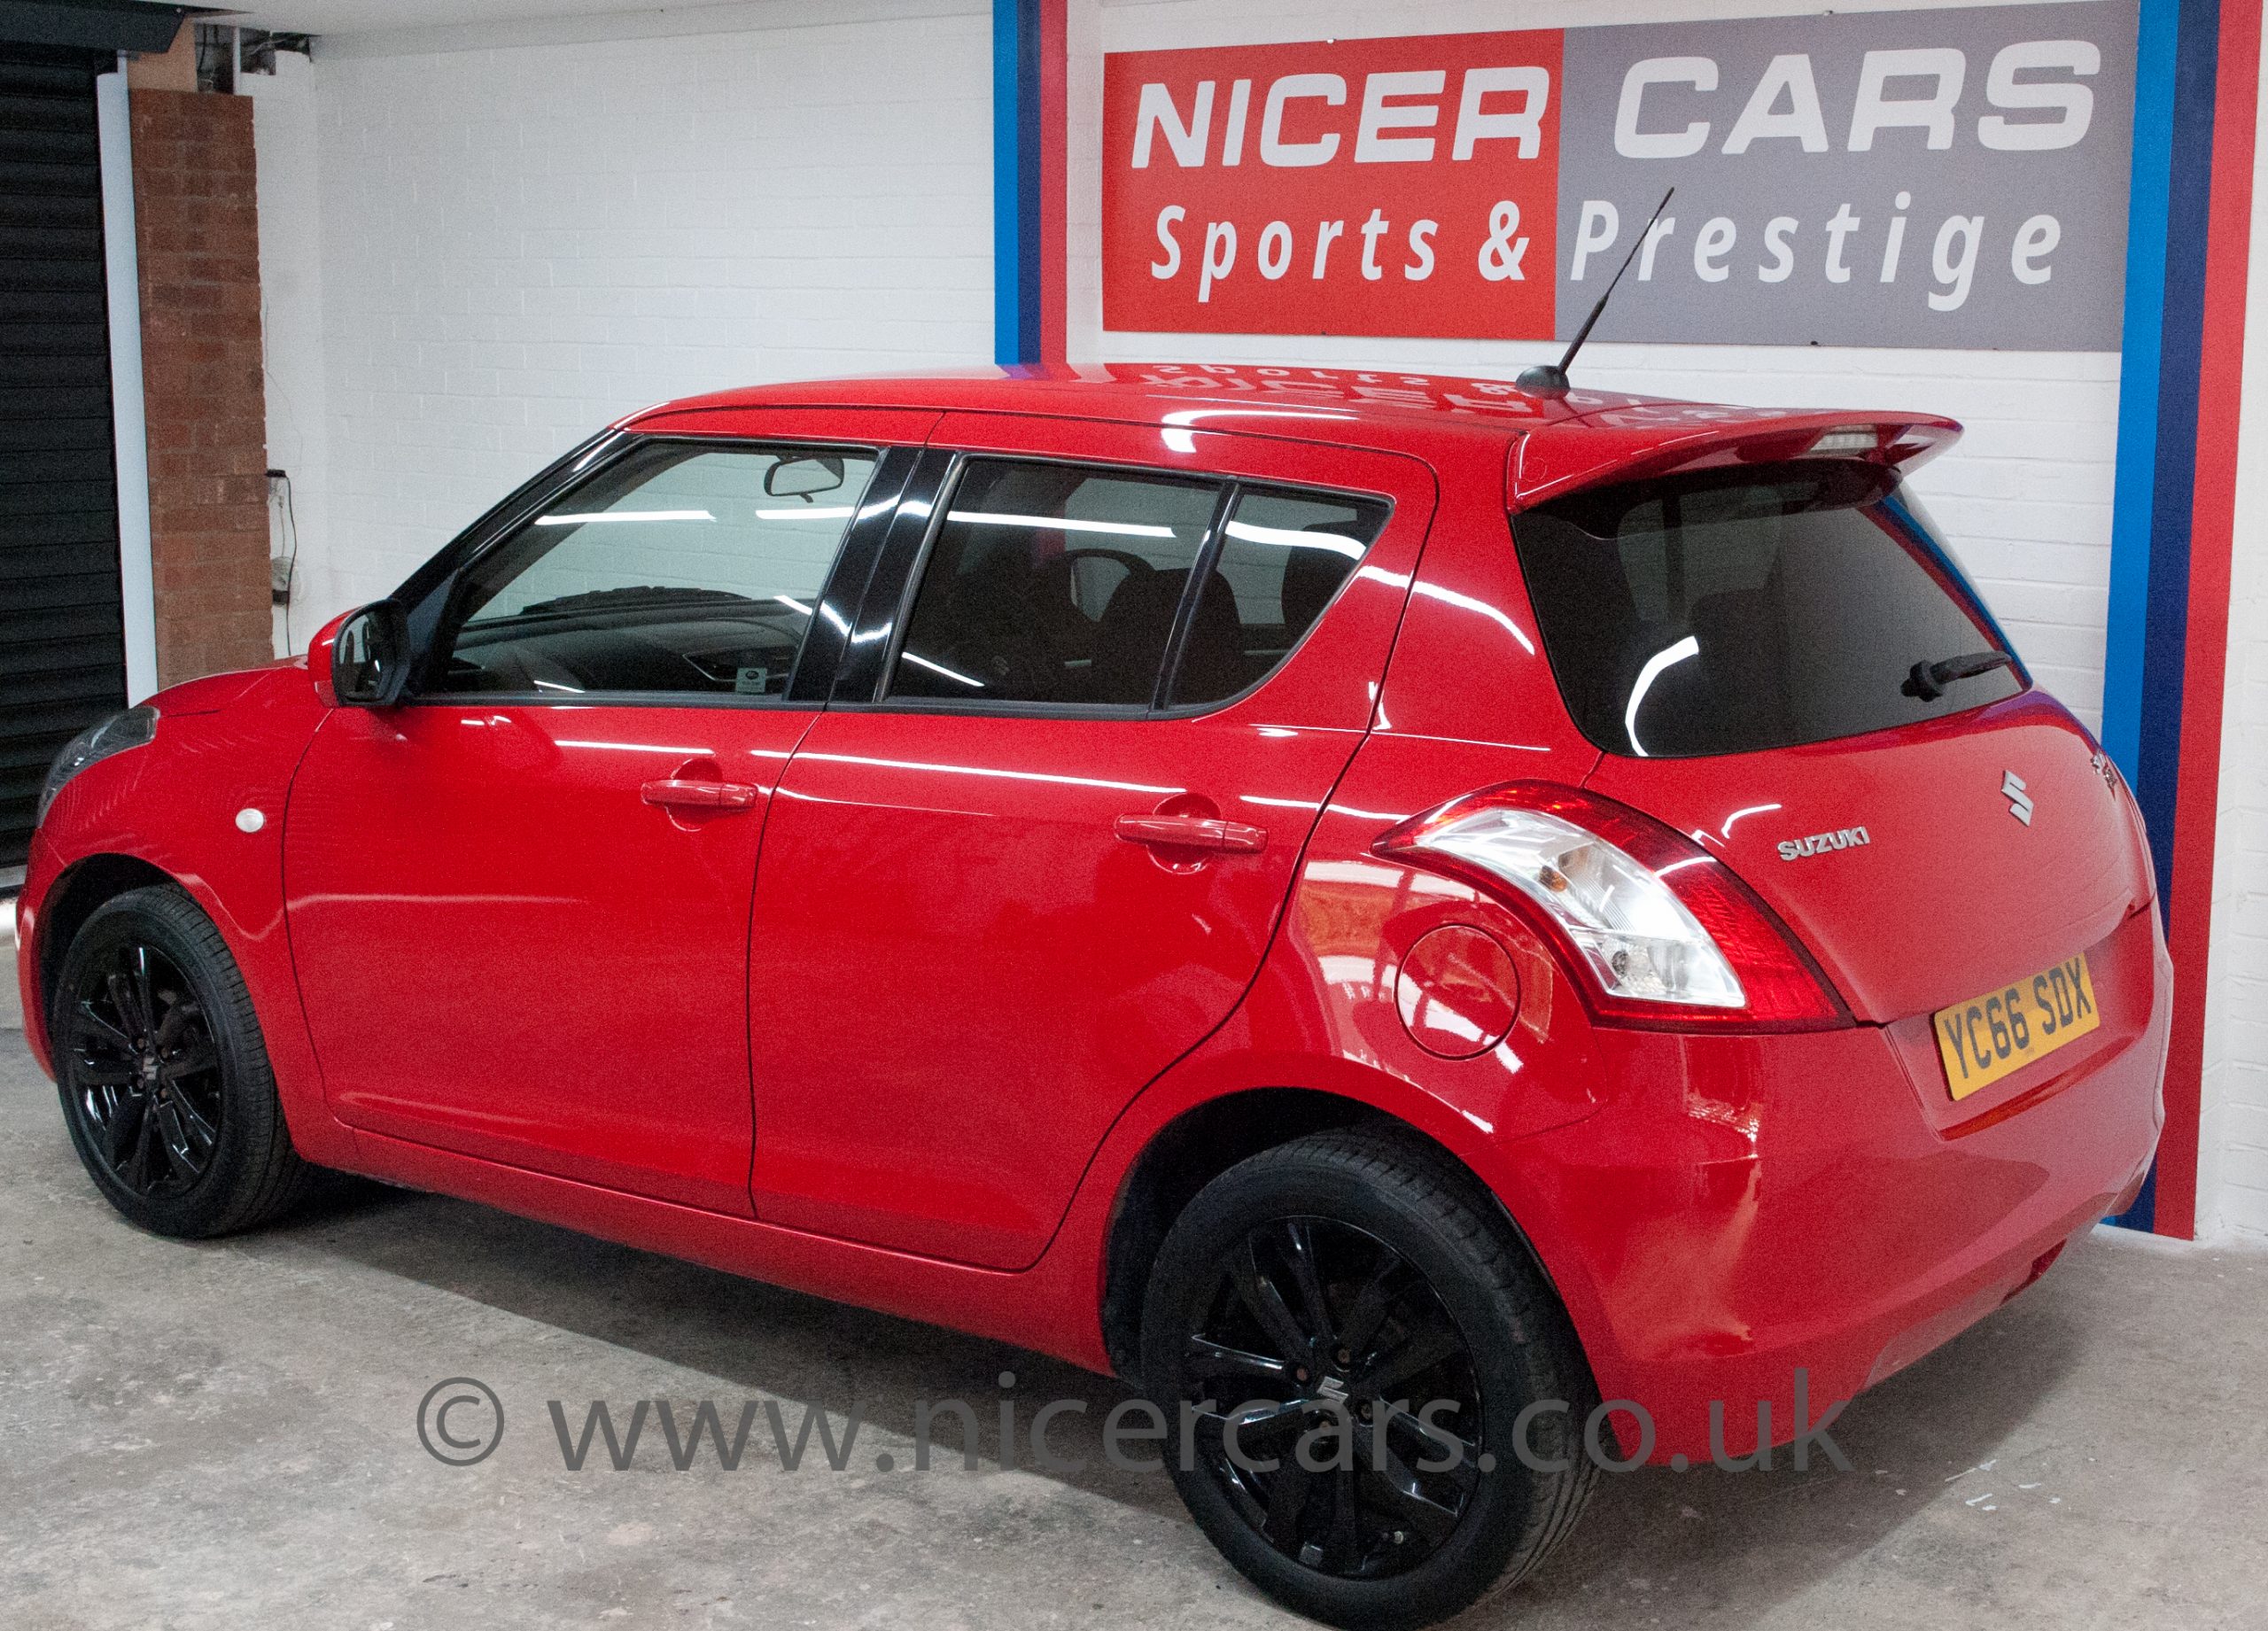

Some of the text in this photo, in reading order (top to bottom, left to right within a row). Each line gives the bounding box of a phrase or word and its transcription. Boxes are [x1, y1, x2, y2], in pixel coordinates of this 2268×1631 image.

[1131, 40, 2101, 168] NICER CARS
[1152, 191, 2062, 312] Sports & Prestige
[1777, 826, 1871, 861] SUZUKI
[1944, 957, 2092, 1079] YC66 SDX
